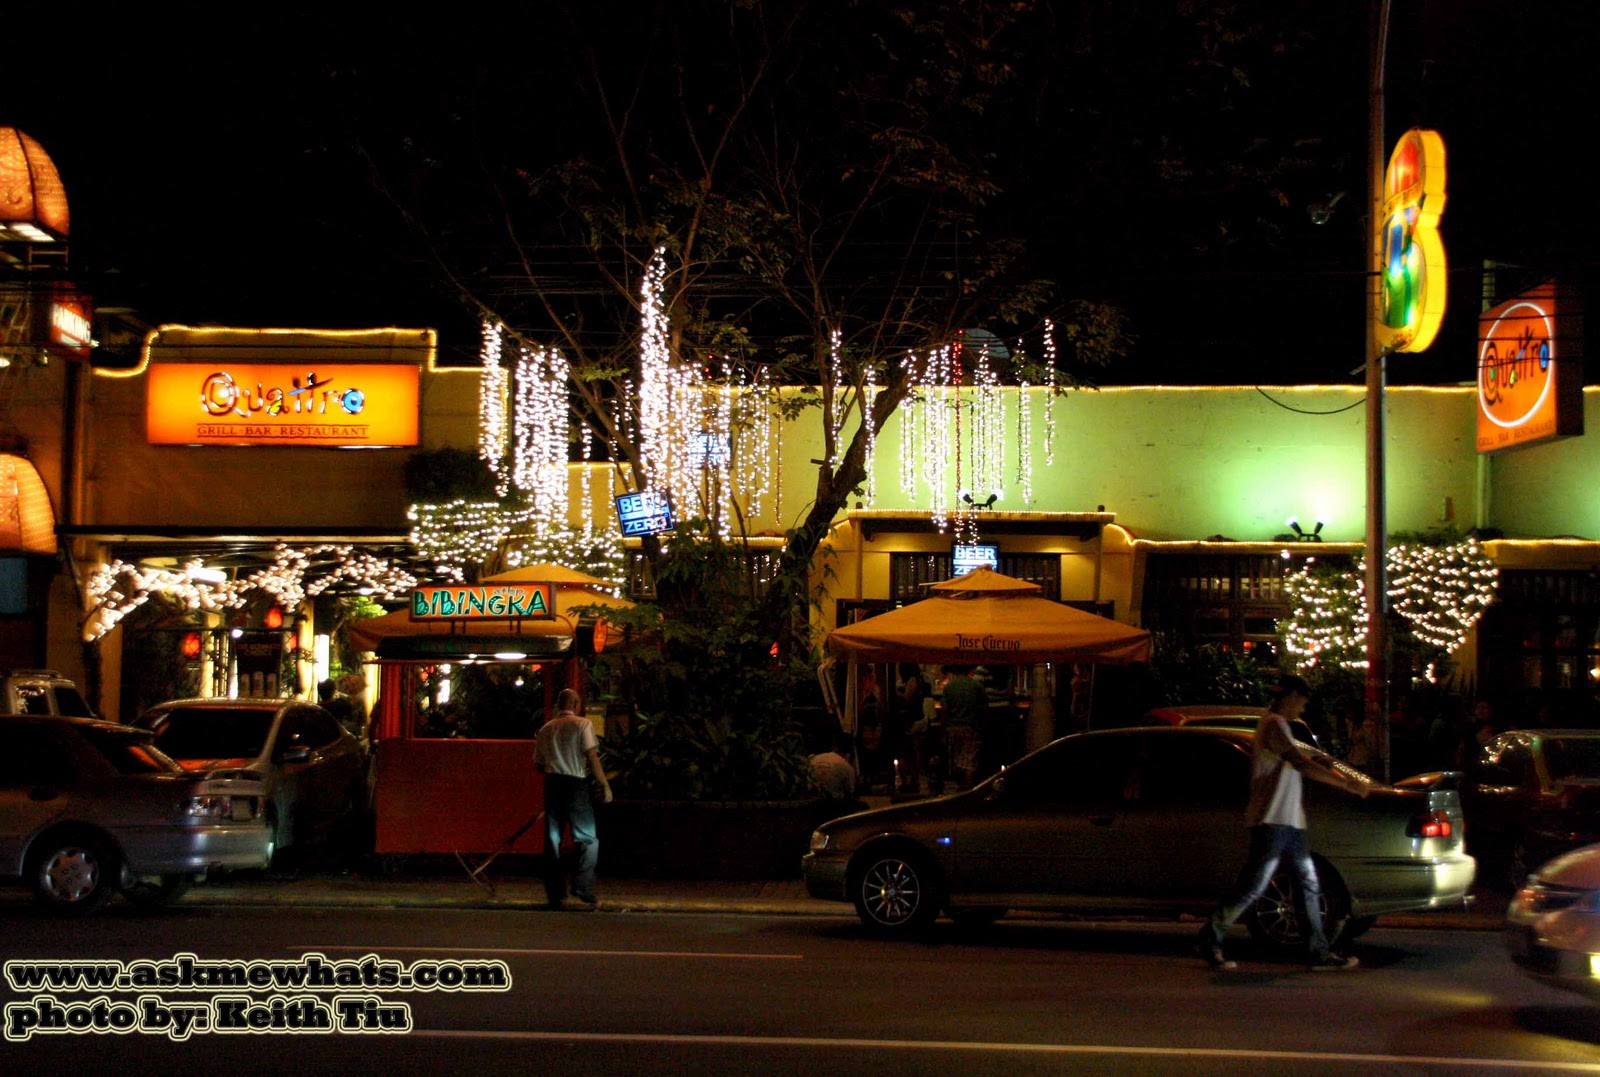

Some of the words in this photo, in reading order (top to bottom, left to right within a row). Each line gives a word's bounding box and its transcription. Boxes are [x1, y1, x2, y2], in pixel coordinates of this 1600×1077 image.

[1483, 325, 1549, 406] Quattro
[201, 372, 365, 418] Quattro
[197, 426, 238, 436] GRILL
[245, 426, 272, 436] BAR
[280, 426, 369, 436] RESTAURANT
[955, 547, 996, 560] BEER
[412, 586, 548, 617] BIBINGKA
[954, 633, 980, 651] Jose
[982, 633, 1021, 652] Cuervo
